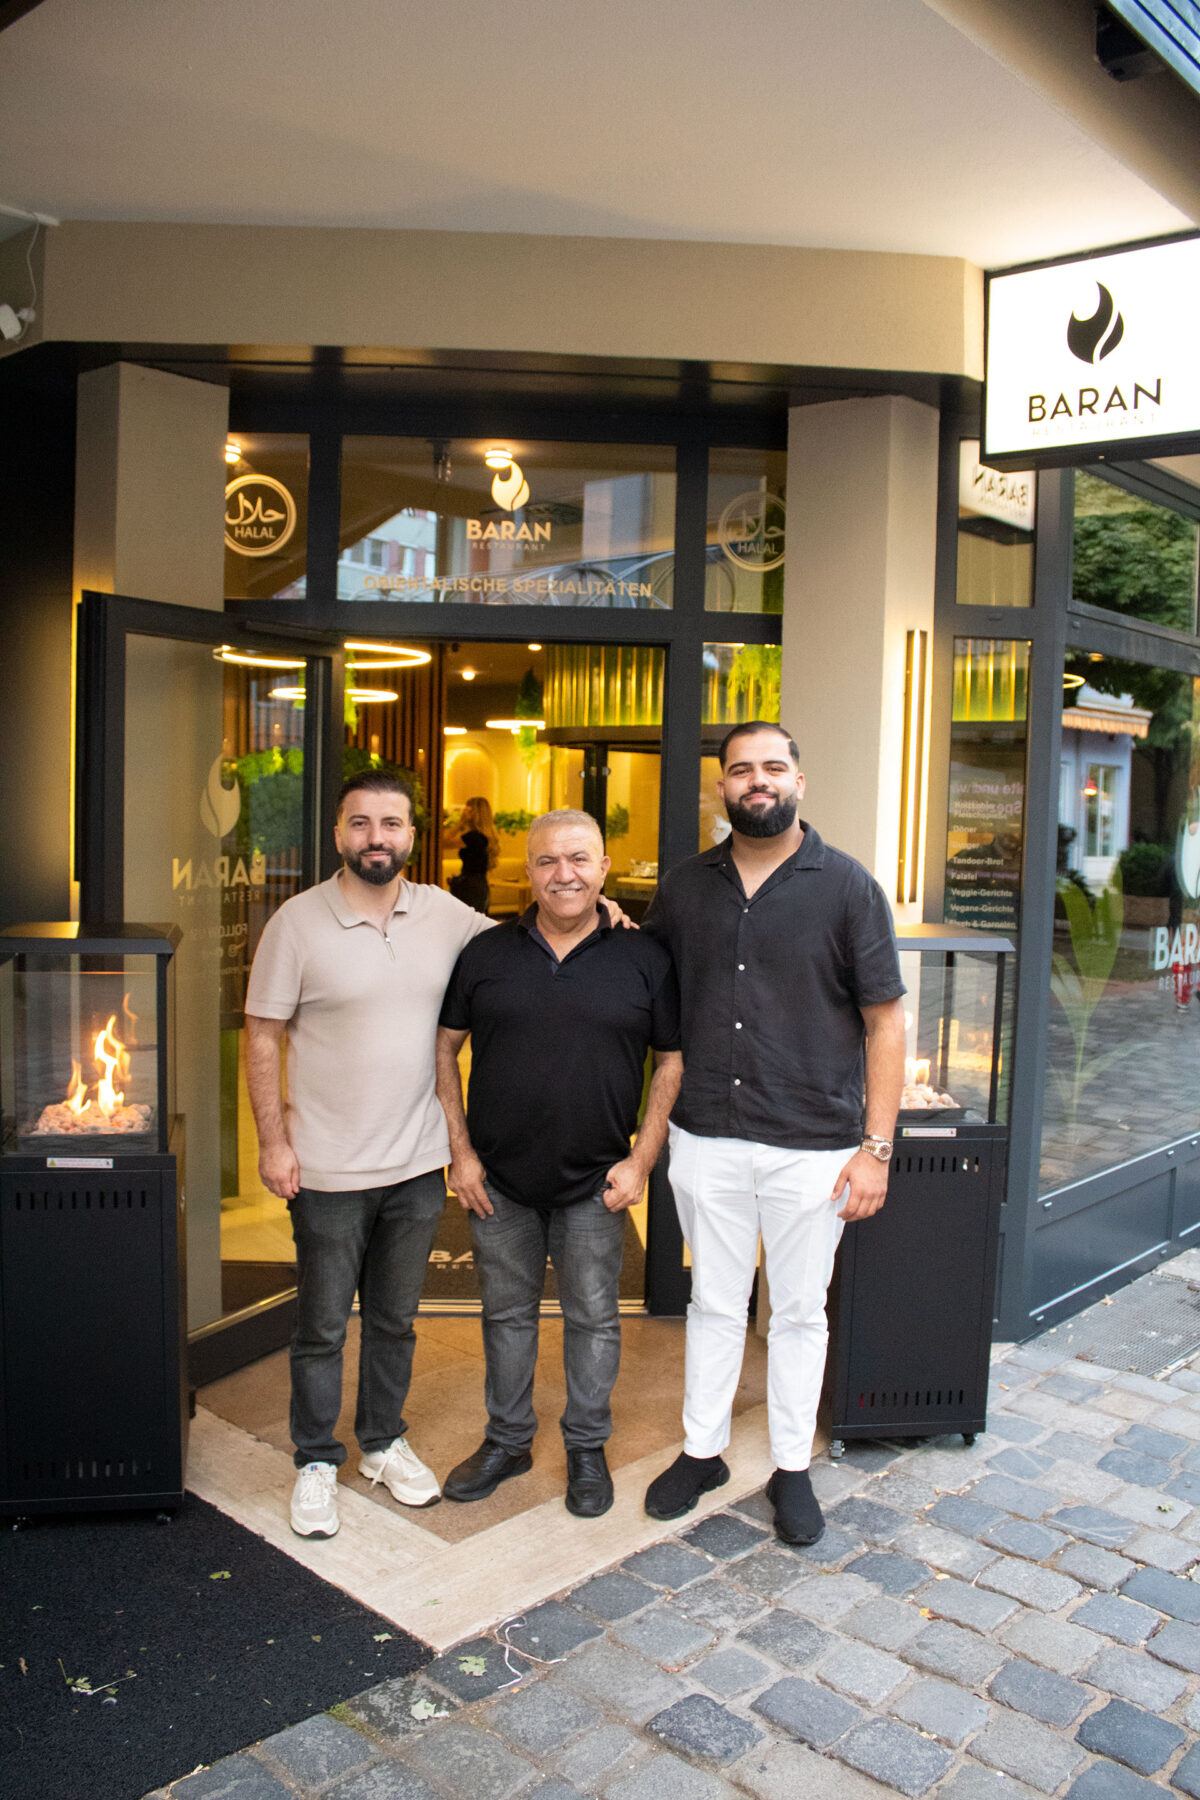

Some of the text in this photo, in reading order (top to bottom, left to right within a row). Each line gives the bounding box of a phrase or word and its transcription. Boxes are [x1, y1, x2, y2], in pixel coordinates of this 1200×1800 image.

[1028, 378, 1162, 423] BARAN
[234, 526, 276, 539] HALAL
[466, 519, 551, 542] BARAN
[471, 541, 546, 552] RESTAURANT
[738, 543, 779, 555] HALAL
[363, 575, 653, 598] ORIENTALISCHE SPEZIALITÄTEN
[951, 871, 978, 881] Falafel
[951, 888, 1014, 898] Veggie-Gerichte
[950, 904, 1015, 914] Vegane-Gerichte
[1154, 924, 1200, 970] BAR
